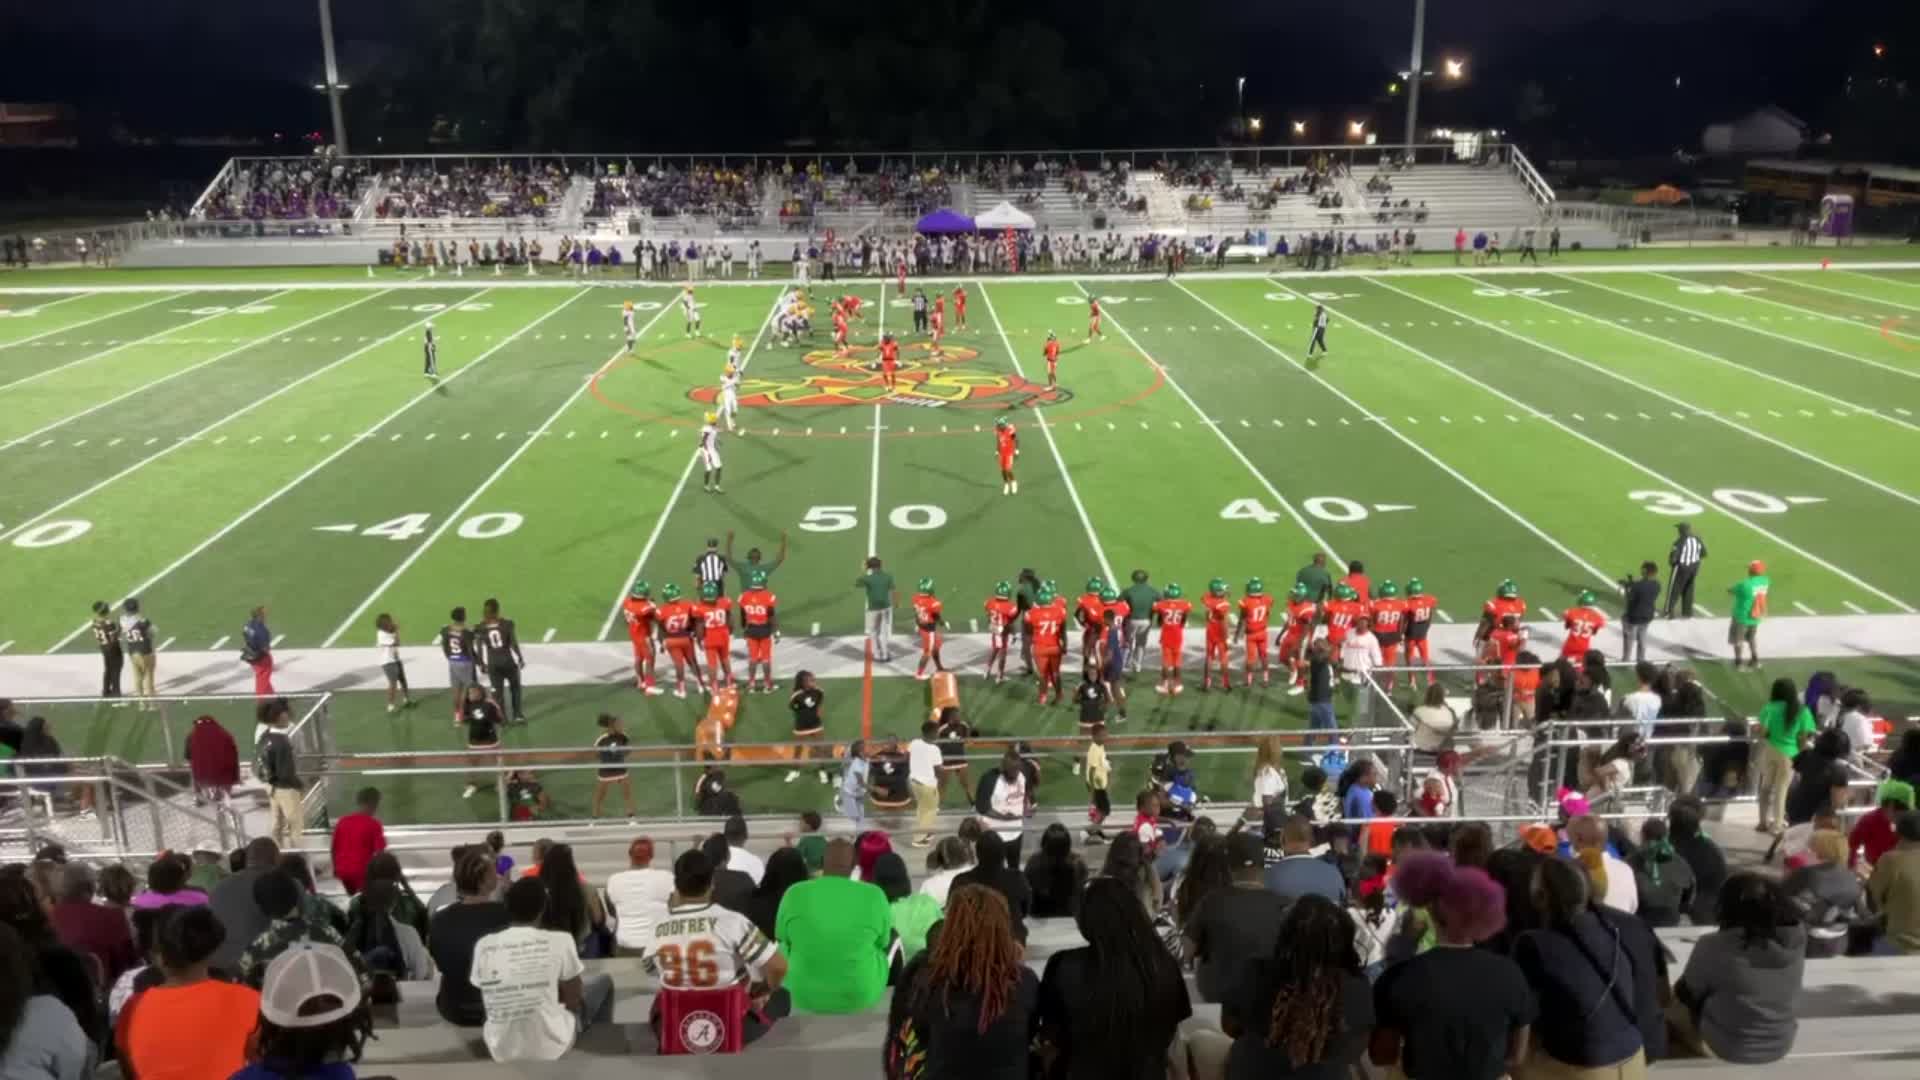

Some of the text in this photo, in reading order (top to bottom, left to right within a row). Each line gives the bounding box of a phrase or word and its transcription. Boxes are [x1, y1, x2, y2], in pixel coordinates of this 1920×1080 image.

[1219, 496, 1369, 524] 40
[1627, 488, 1788, 515] 30
[360, 512, 524, 540] 40
[798, 504, 948, 532] 50
[704, 609, 726, 628] 29
[656, 940, 719, 987] 96
